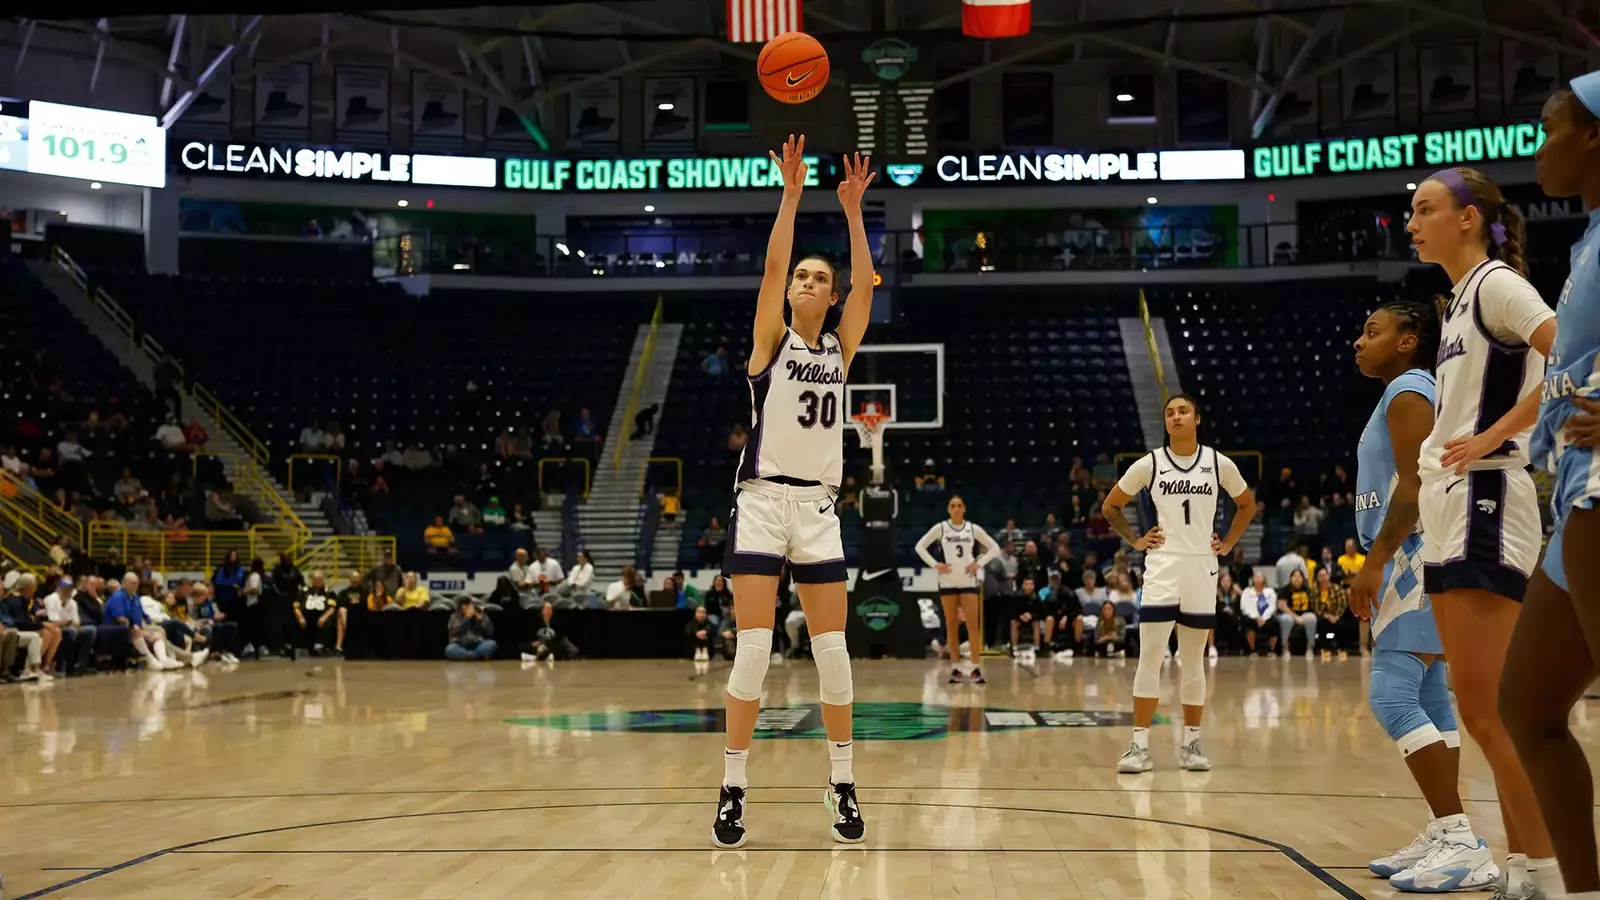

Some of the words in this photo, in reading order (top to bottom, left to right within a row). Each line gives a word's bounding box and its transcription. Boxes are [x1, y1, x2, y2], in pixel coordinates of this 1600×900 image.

[42, 135, 128, 164] 101.9
[1253, 143, 1321, 178] GULF
[1327, 134, 1418, 172] COAST
[504, 158, 570, 190] GULF
[576, 159, 662, 189] COAST
[667, 157, 820, 188] SHOWCAE
[797, 390, 837, 429] 30
[1159, 480, 1213, 496] Wildcats
[1182, 499, 1191, 525] 1
[956, 545, 963, 558] 3
